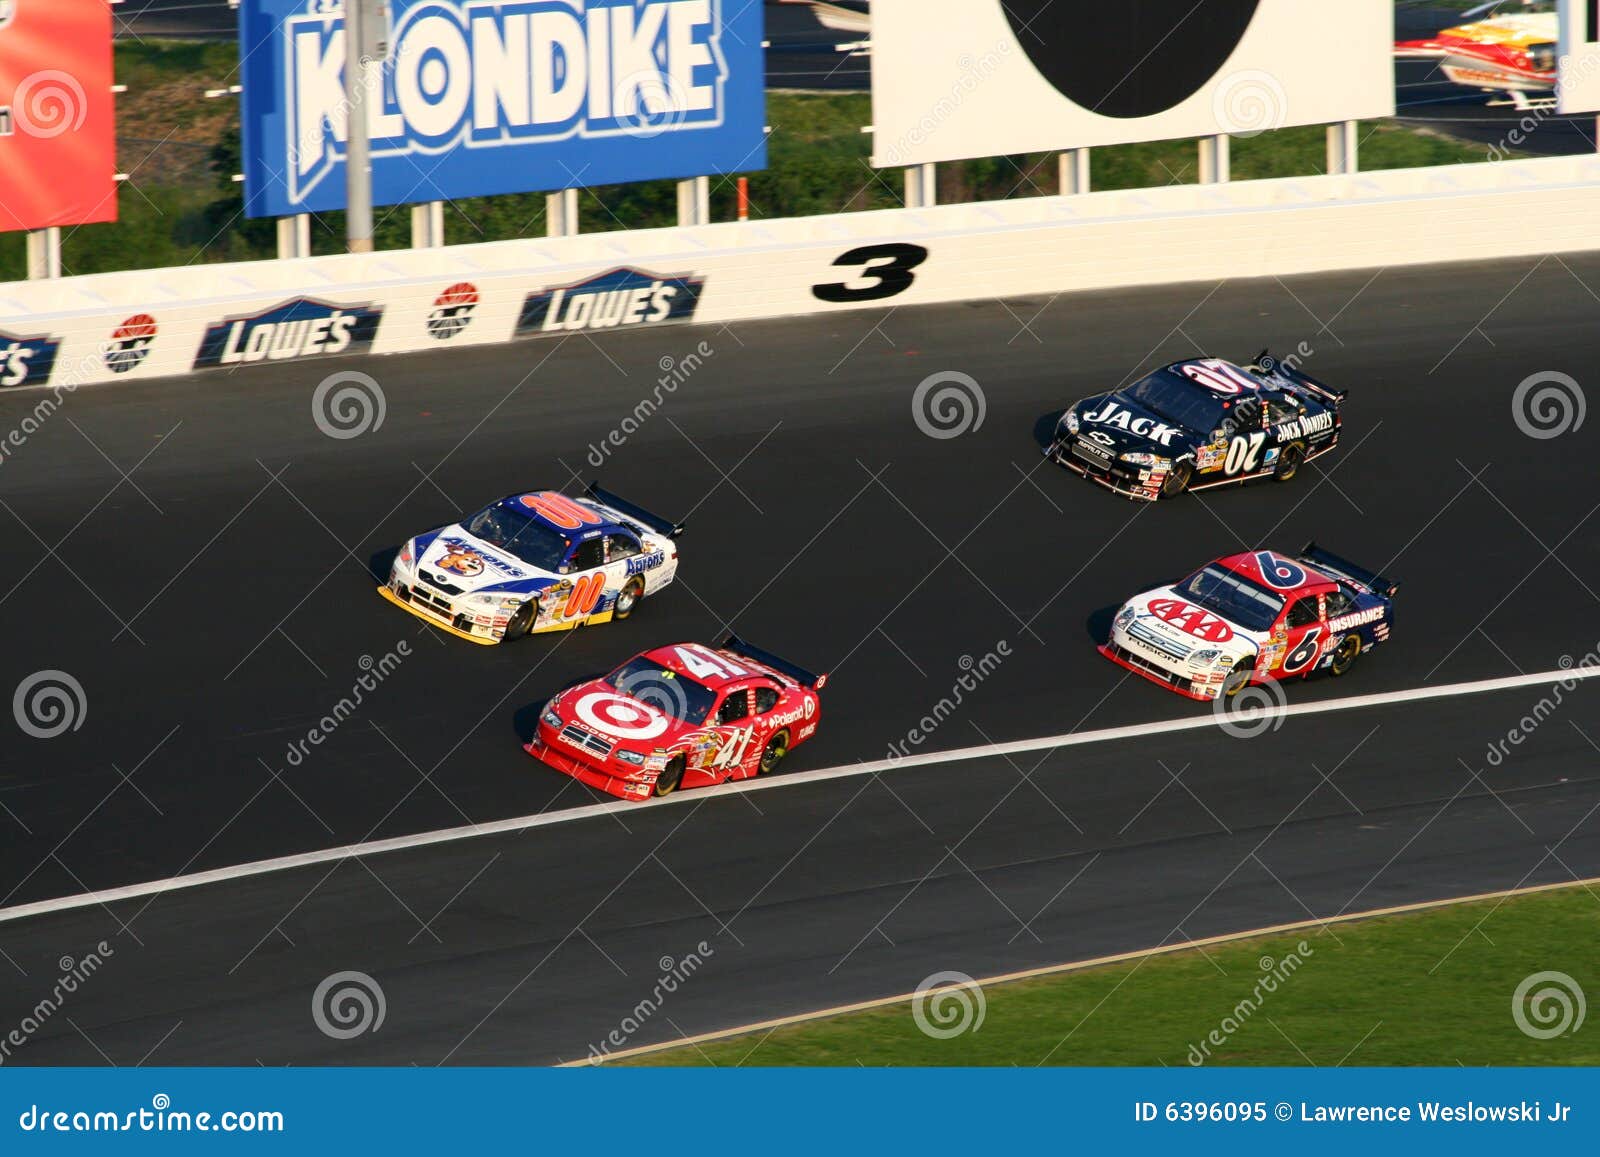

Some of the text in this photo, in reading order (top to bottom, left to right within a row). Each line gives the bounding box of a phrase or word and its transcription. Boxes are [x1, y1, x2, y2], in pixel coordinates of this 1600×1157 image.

[296, 0, 713, 175] KLONDIKE
[811, 243, 928, 302] 3
[541, 280, 678, 332] LOWE'S
[220, 311, 357, 364] LOWE'S
[1182, 359, 1261, 393] 07
[1083, 402, 1183, 447] JACK
[1277, 421, 1302, 443] JACK
[1224, 433, 1266, 475] 07
[1255, 551, 1307, 590] 6
[563, 572, 607, 618] 00
[1151, 600, 1230, 641] AAA
[1329, 606, 1384, 633] INSURANCE
[674, 643, 748, 680] 41
[1129, 636, 1178, 663] FUSION
[1283, 626, 1322, 673] 6
[570, 719, 618, 745] DODGE
[774, 705, 804, 727] Polaroid
[711, 724, 755, 772] 41
